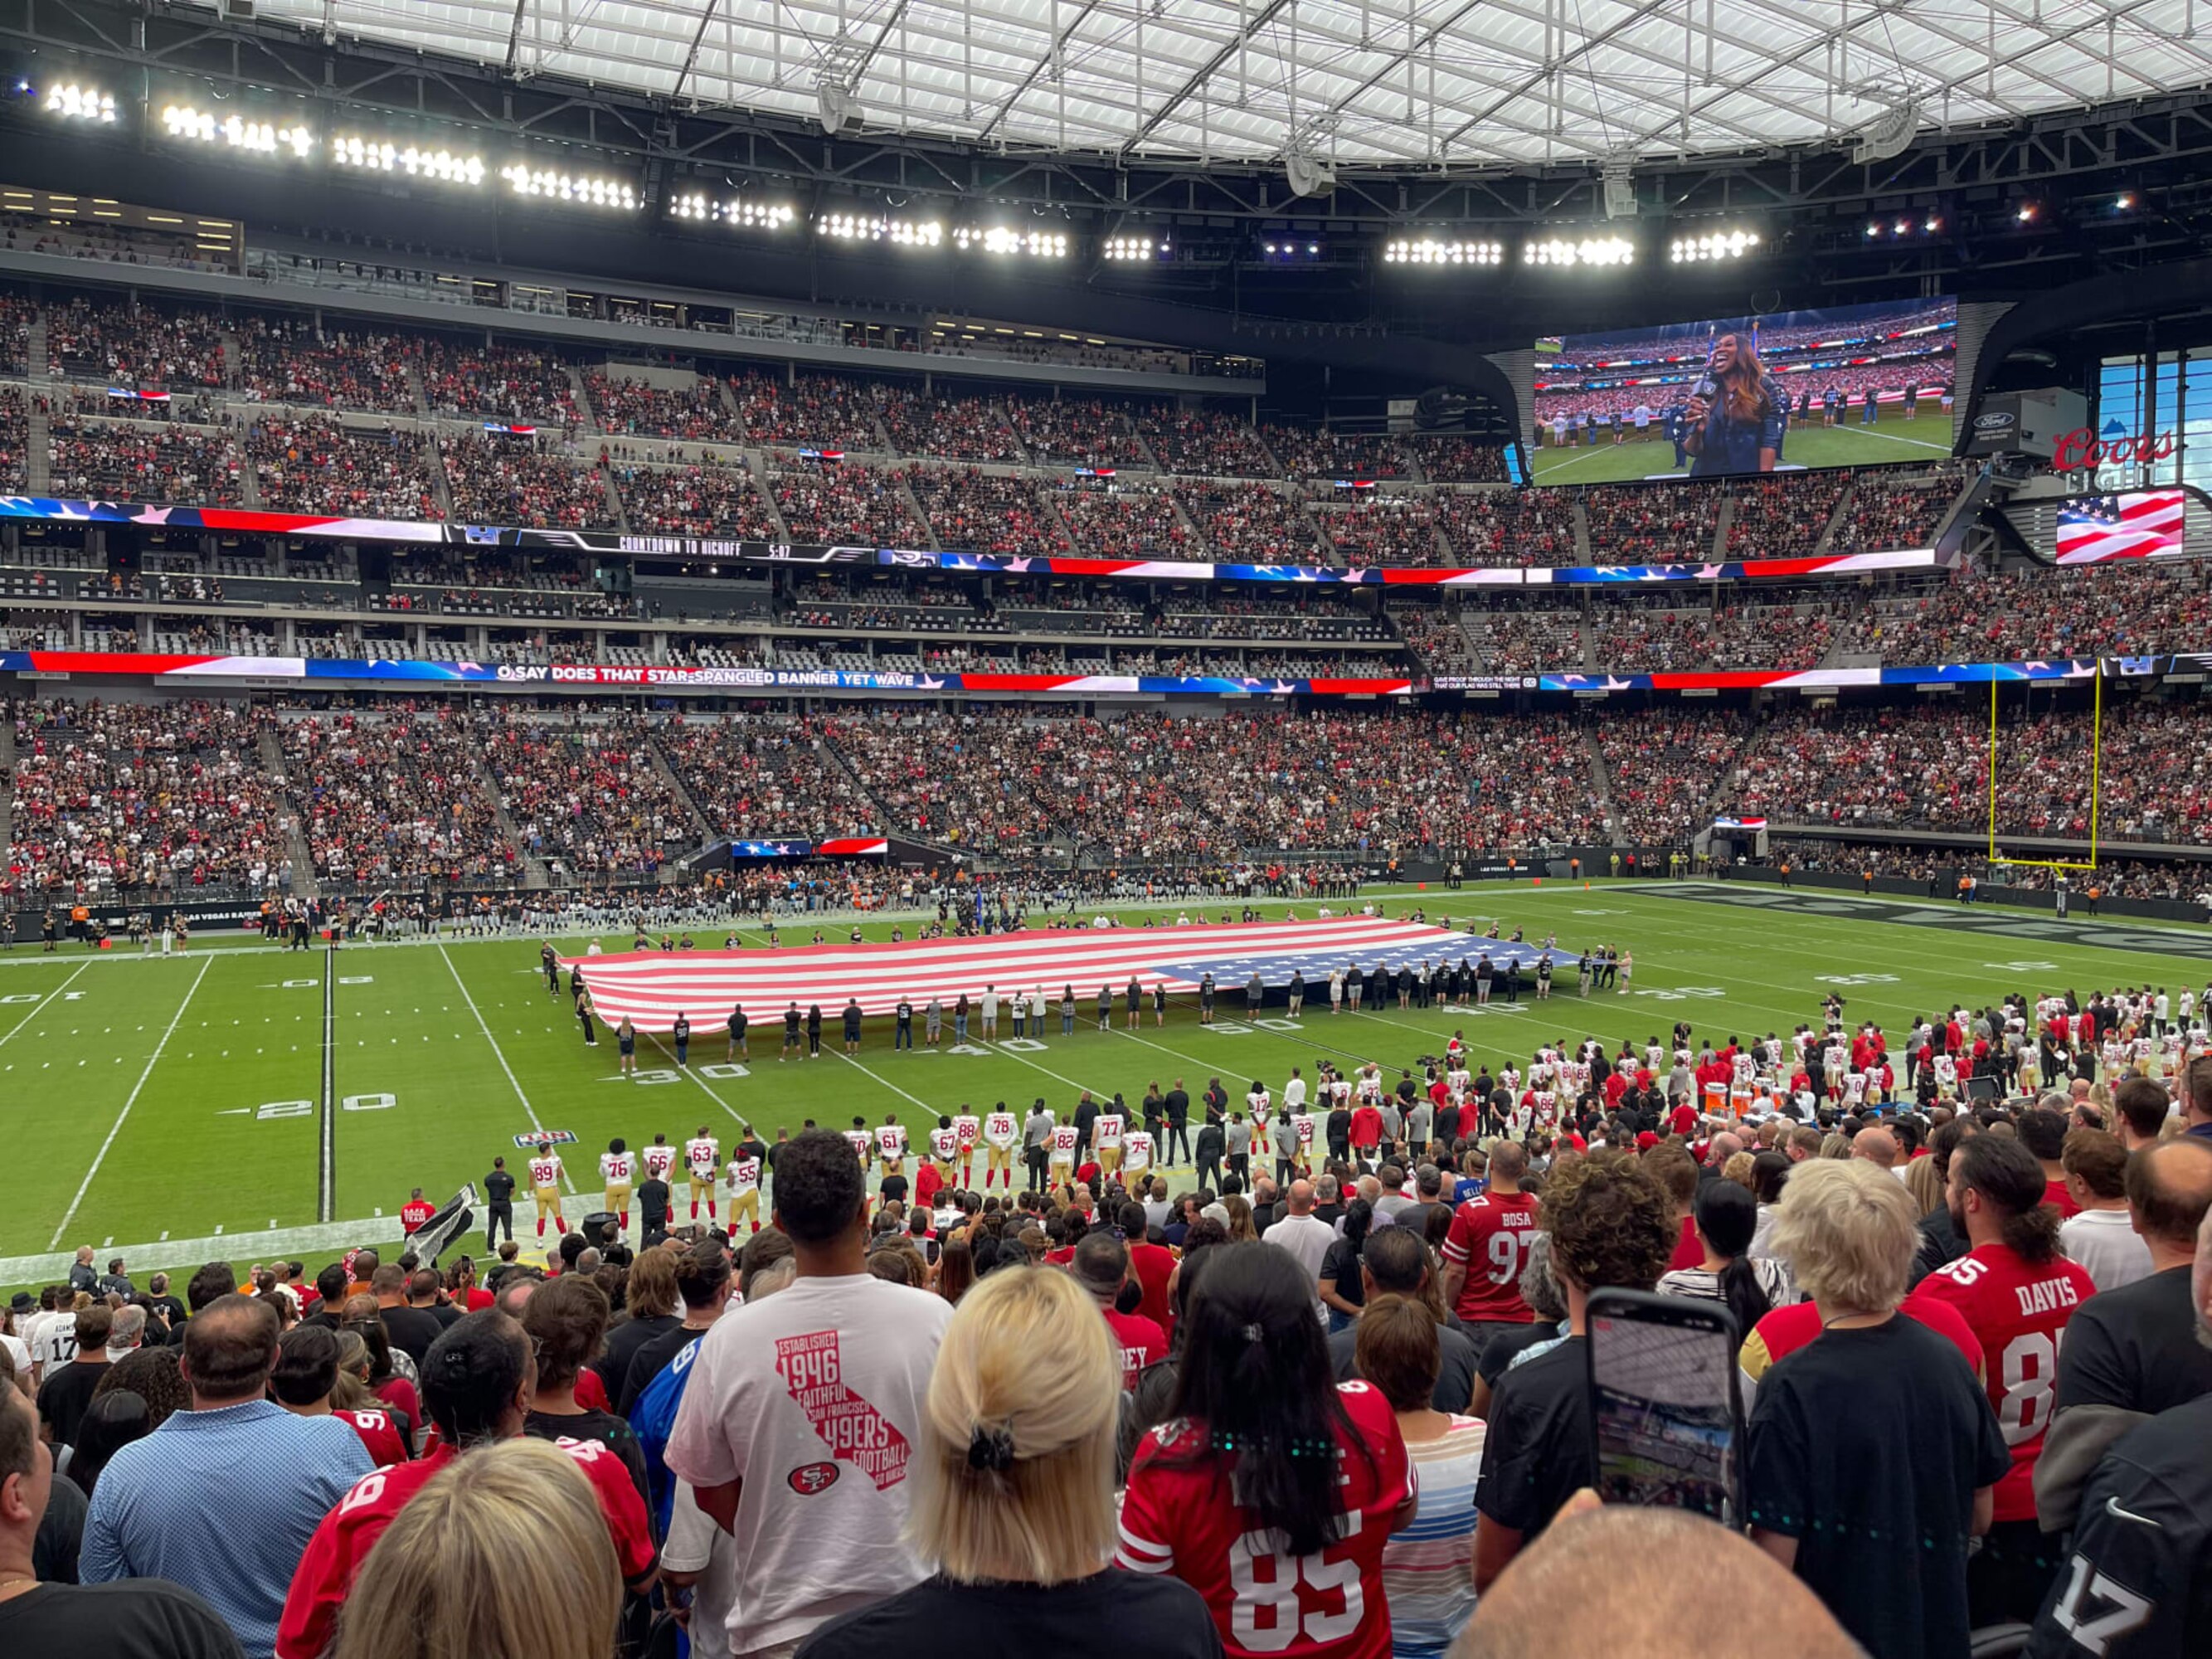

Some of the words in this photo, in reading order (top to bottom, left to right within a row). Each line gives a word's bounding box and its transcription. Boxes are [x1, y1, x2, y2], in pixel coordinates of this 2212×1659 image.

[2053, 428, 2177, 471] Coors
[2064, 462, 2160, 494] LIGHT
[620, 536, 681, 552] COUNTDOWN
[686, 540, 698, 554] TO
[769, 544, 790, 558] 5:07
[498, 666, 508, 679] O
[516, 666, 549, 679] SAY
[552, 667, 596, 680] DOES
[600, 668, 644, 681] THAT
[647, 669, 775, 684] STAR-SPANGLED
[778, 672, 839, 685] BANNER
[843, 673, 870, 685] YET
[874, 674, 914, 686] WAVE
[1198, 1018, 1305, 1034] 50
[946, 1039, 1049, 1056] 40
[630, 1063, 751, 1086] 30
[255, 1092, 397, 1120] 20
[1255, 1098, 1267, 1112] 17
[959, 1124, 975, 1138] 88
[994, 1120, 1009, 1134] 78
[1102, 1121, 1118, 1136] 77
[1297, 1121, 1312, 1136] 32
[882, 1135, 897, 1149] 61
[940, 1136, 955, 1150] 67
[1057, 1135, 1074, 1149] 82
[1132, 1141, 1148, 1154] 75
[649, 1155, 668, 1170] 66
[693, 1146, 711, 1162] 63
[534, 1165, 553, 1181] 89
[608, 1161, 628, 1177] 76
[738, 1165, 756, 1183] 55
[405, 1214, 425, 1223] TEAM
[1502, 1212, 1532, 1227] BOSA
[1487, 1229, 1549, 1285] 97
[2015, 1276, 2078, 1316] DAVIS
[51, 1336, 78, 1362] 17
[779, 1332, 836, 1355] ESTABLISHED
[780, 1349, 839, 1391] 1946
[1998, 1327, 2067, 1446] 8
[797, 1383, 848, 1410] FAITHFUL
[809, 1406, 826, 1423] SAN
[827, 1399, 870, 1418] FRANCISCO
[824, 1413, 889, 1451] 49ERS
[853, 1442, 907, 1473] FOOTBALL
[1228, 1508, 1364, 1652] 85
[2052, 1553, 2155, 1659] 17
